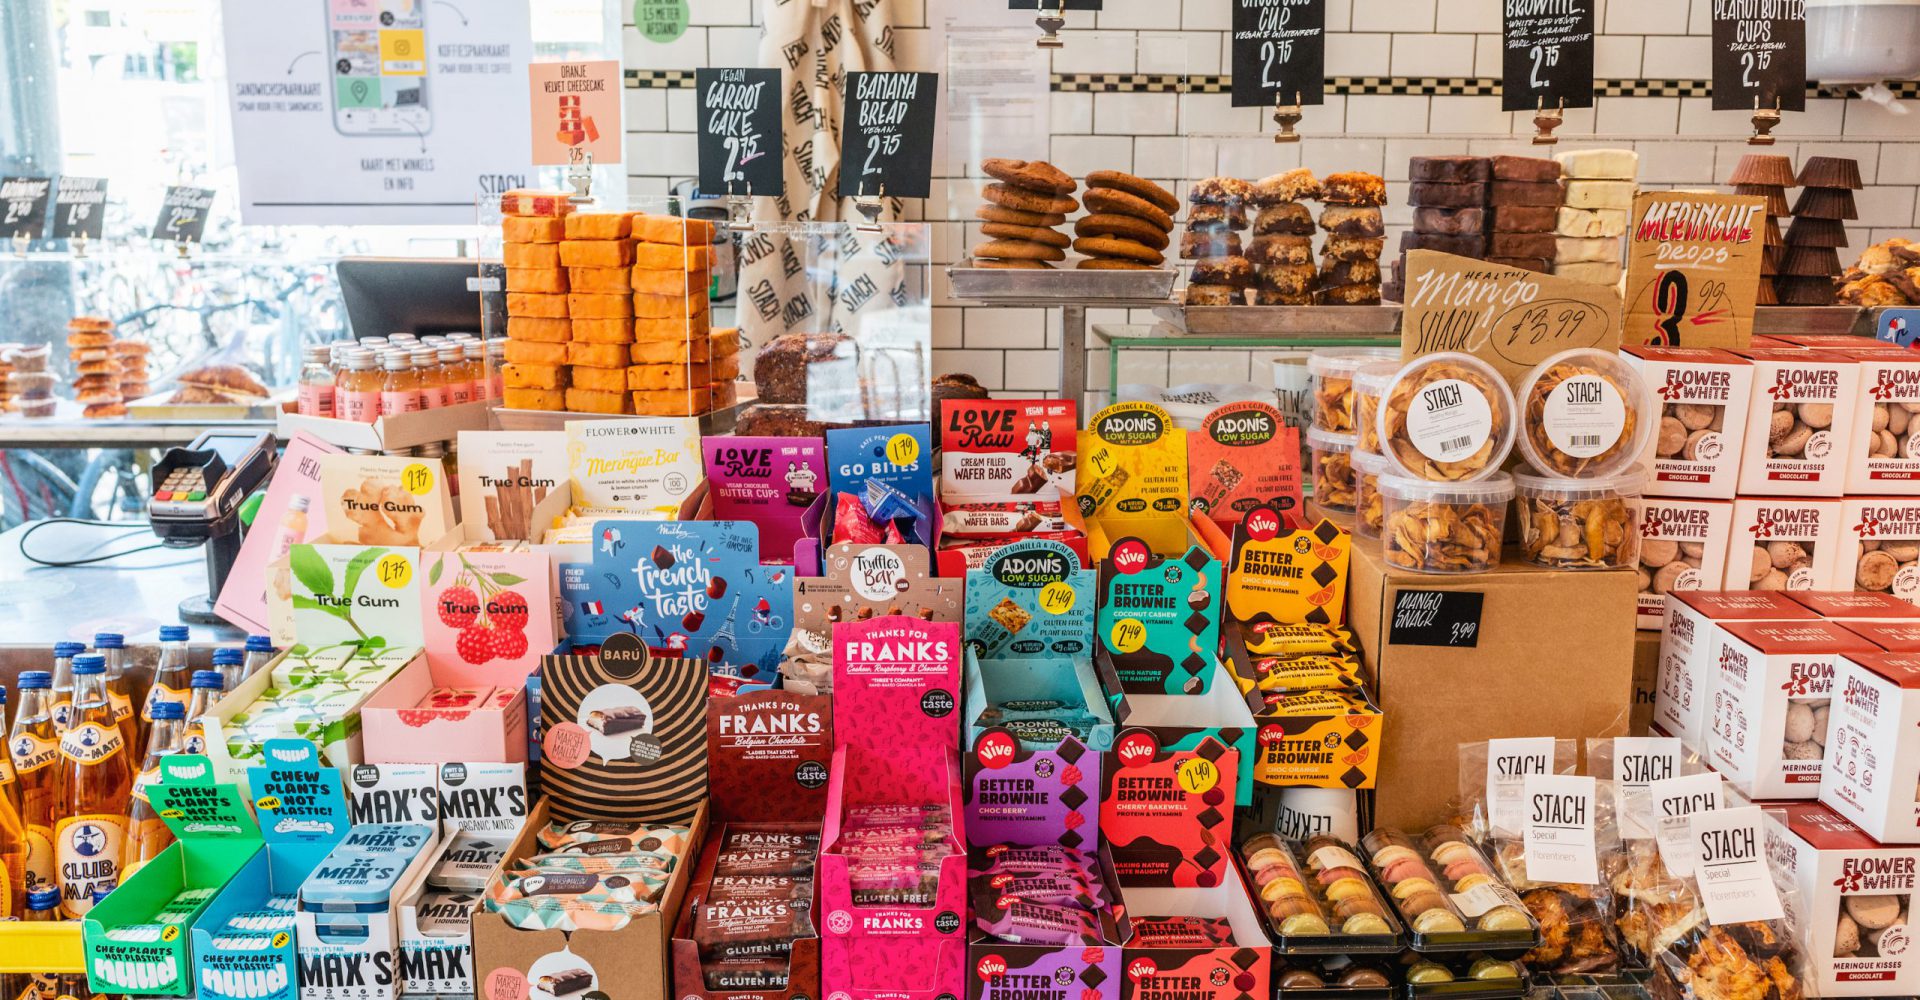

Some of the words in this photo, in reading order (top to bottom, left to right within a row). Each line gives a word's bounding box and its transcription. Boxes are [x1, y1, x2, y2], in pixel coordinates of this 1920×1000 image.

[1714, 0, 1758, 20] PEANUT
[1761, 0, 1806, 20] BUTTER
[1259, 7, 1290, 31] CUP
[1236, 31, 1260, 39] VEGAN
[1736, 20, 1771, 42] CUPS
[561, 65, 587, 78] ORANJE
[720, 69, 745, 82] VEGAN
[544, 81, 565, 93] VELVET
[567, 79, 605, 92] CHEESECAKE
[856, 74, 918, 100] BANANA
[706, 82, 765, 110] CARROT
[859, 101, 908, 126] BREAD
[709, 111, 753, 136] CAKE
[386, 159, 400, 171] MET
[384, 177, 396, 190] EN
[398, 177, 413, 190] INFO
[479, 175, 526, 194] STACH
[1637, 201, 1763, 243] MERINGUE
[1655, 243, 1728, 264] DROPS
[1464, 271, 1531, 281] HEALTHY
[841, 273, 878, 311] STACH
[1411, 268, 1540, 308] Mango
[750, 279, 781, 321] STACH
[1413, 309, 1479, 355] SNACK
[1666, 369, 1731, 386] FLOWER
[1776, 369, 1838, 385] FLOWER
[1424, 382, 1463, 412] STACH
[1567, 382, 1602, 403] STACH
[1683, 385, 1731, 400] WHITE
[1791, 385, 1837, 399] WHITE
[1025, 406, 1044, 416] VEGAN
[950, 409, 1017, 432] LOVE
[1104, 418, 1156, 433] ADONIS
[1217, 418, 1269, 434] ADONIS
[586, 427, 630, 437] FLOWER
[638, 426, 675, 436] WHITE
[958, 425, 1015, 448] Raw
[1128, 432, 1157, 440] SUGAR
[586, 455, 654, 477] Meringue
[655, 448, 680, 466] Bar
[715, 448, 773, 466] LOVE
[986, 457, 1006, 467] FILLED
[840, 464, 865, 477] GO
[954, 468, 985, 480] WAFER
[988, 468, 1012, 480] BARS
[1655, 463, 1691, 473] MERINGUE
[1692, 464, 1716, 473] KISSES
[478, 475, 514, 488] True
[517, 476, 555, 488] Gum
[1668, 473, 1699, 481] CHOCOLATE
[719, 488, 753, 498] BUTTER
[756, 489, 779, 498] CUPS
[343, 499, 379, 511] True
[384, 501, 423, 513] Gum
[1757, 507, 1820, 524] FLOWER
[1248, 515, 1277, 533] Vive
[1774, 523, 1819, 537] WHITE
[671, 544, 696, 564] the
[1245, 549, 1293, 565] BETTER
[854, 554, 899, 571] Truffles
[1001, 558, 1062, 574] ADONIS
[632, 557, 711, 595] french
[864, 569, 895, 586] Bar
[1002, 575, 1025, 583] LOW
[1028, 574, 1061, 582] SUGAR
[1243, 562, 1304, 580] BROWNIE
[799, 581, 806, 595] 4
[1114, 583, 1164, 596] BETTER
[314, 594, 352, 607] True
[357, 595, 399, 608] Gum
[645, 582, 709, 619] taste
[1113, 596, 1177, 609] BROWNIE
[1397, 592, 1443, 610] MANGO
[1395, 609, 1438, 628] SNACK
[866, 629, 905, 640] THANKS
[909, 630, 928, 640] FOR
[604, 647, 640, 661] BARÚ
[846, 641, 949, 662] FRANKS
[1848, 675, 1880, 702] FLOWER
[739, 702, 777, 713] THANKS
[781, 702, 800, 711] FOR
[922, 700, 953, 709] taste
[1855, 697, 1878, 717] WHITE
[720, 713, 820, 734] FRANKS
[980, 741, 1013, 761] Vive
[797, 771, 827, 780] taste
[1622, 755, 1673, 782] STACH
[271, 770, 320, 783] CHEW
[1118, 777, 1174, 790] BETTER
[264, 784, 331, 796] PLANTS
[979, 778, 1035, 792] BETTER
[285, 796, 316, 805] NOT
[439, 785, 526, 820] MAX'S
[979, 792, 1049, 805] BROWNIE
[1117, 789, 1187, 802] BROWNIE
[273, 807, 332, 816] PLASTIC!
[352, 786, 438, 826] MAX'S
[1533, 793, 1585, 825] STACH
[458, 819, 491, 832] ORGANIC
[492, 818, 514, 830] MINTS
[1532, 829, 1557, 841] Special
[1700, 827, 1756, 861] STACH
[1533, 850, 1577, 862] Florentiners
[1842, 857, 1916, 877] FLOWER
[1860, 874, 1916, 890] WHITE
[855, 895, 899, 903] GLUTEN
[902, 894, 929, 903] FREE
[707, 904, 788, 920] FRANKS
[863, 917, 923, 929] FRANKS
[96, 945, 126, 954] CHEW
[129, 946, 173, 956] PLANTS
[1833, 961, 1877, 970] MERINGUE
[1879, 960, 1902, 969] KISSES
[990, 975, 1051, 989] BETTER
[1849, 972, 1885, 980] CHOCOLATE
